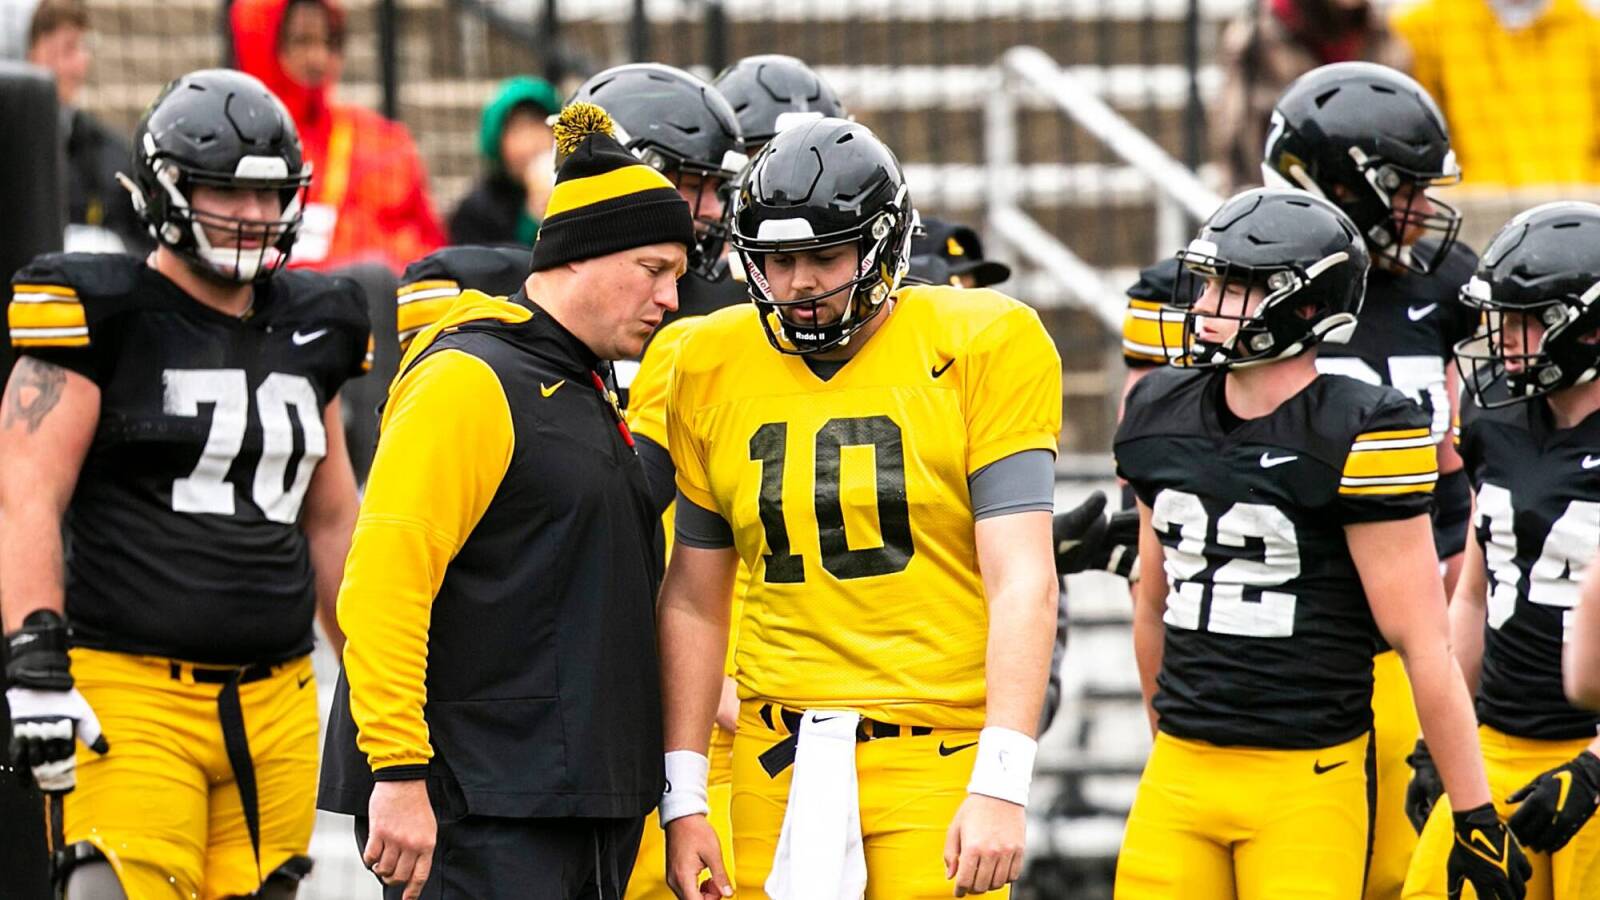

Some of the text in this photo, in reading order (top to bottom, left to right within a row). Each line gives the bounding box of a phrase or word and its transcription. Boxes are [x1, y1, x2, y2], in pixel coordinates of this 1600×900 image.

[162, 369, 326, 523] 70
[749, 415, 915, 583] 10
[1151, 488, 1301, 637] 22
[1474, 482, 1600, 646] 34
